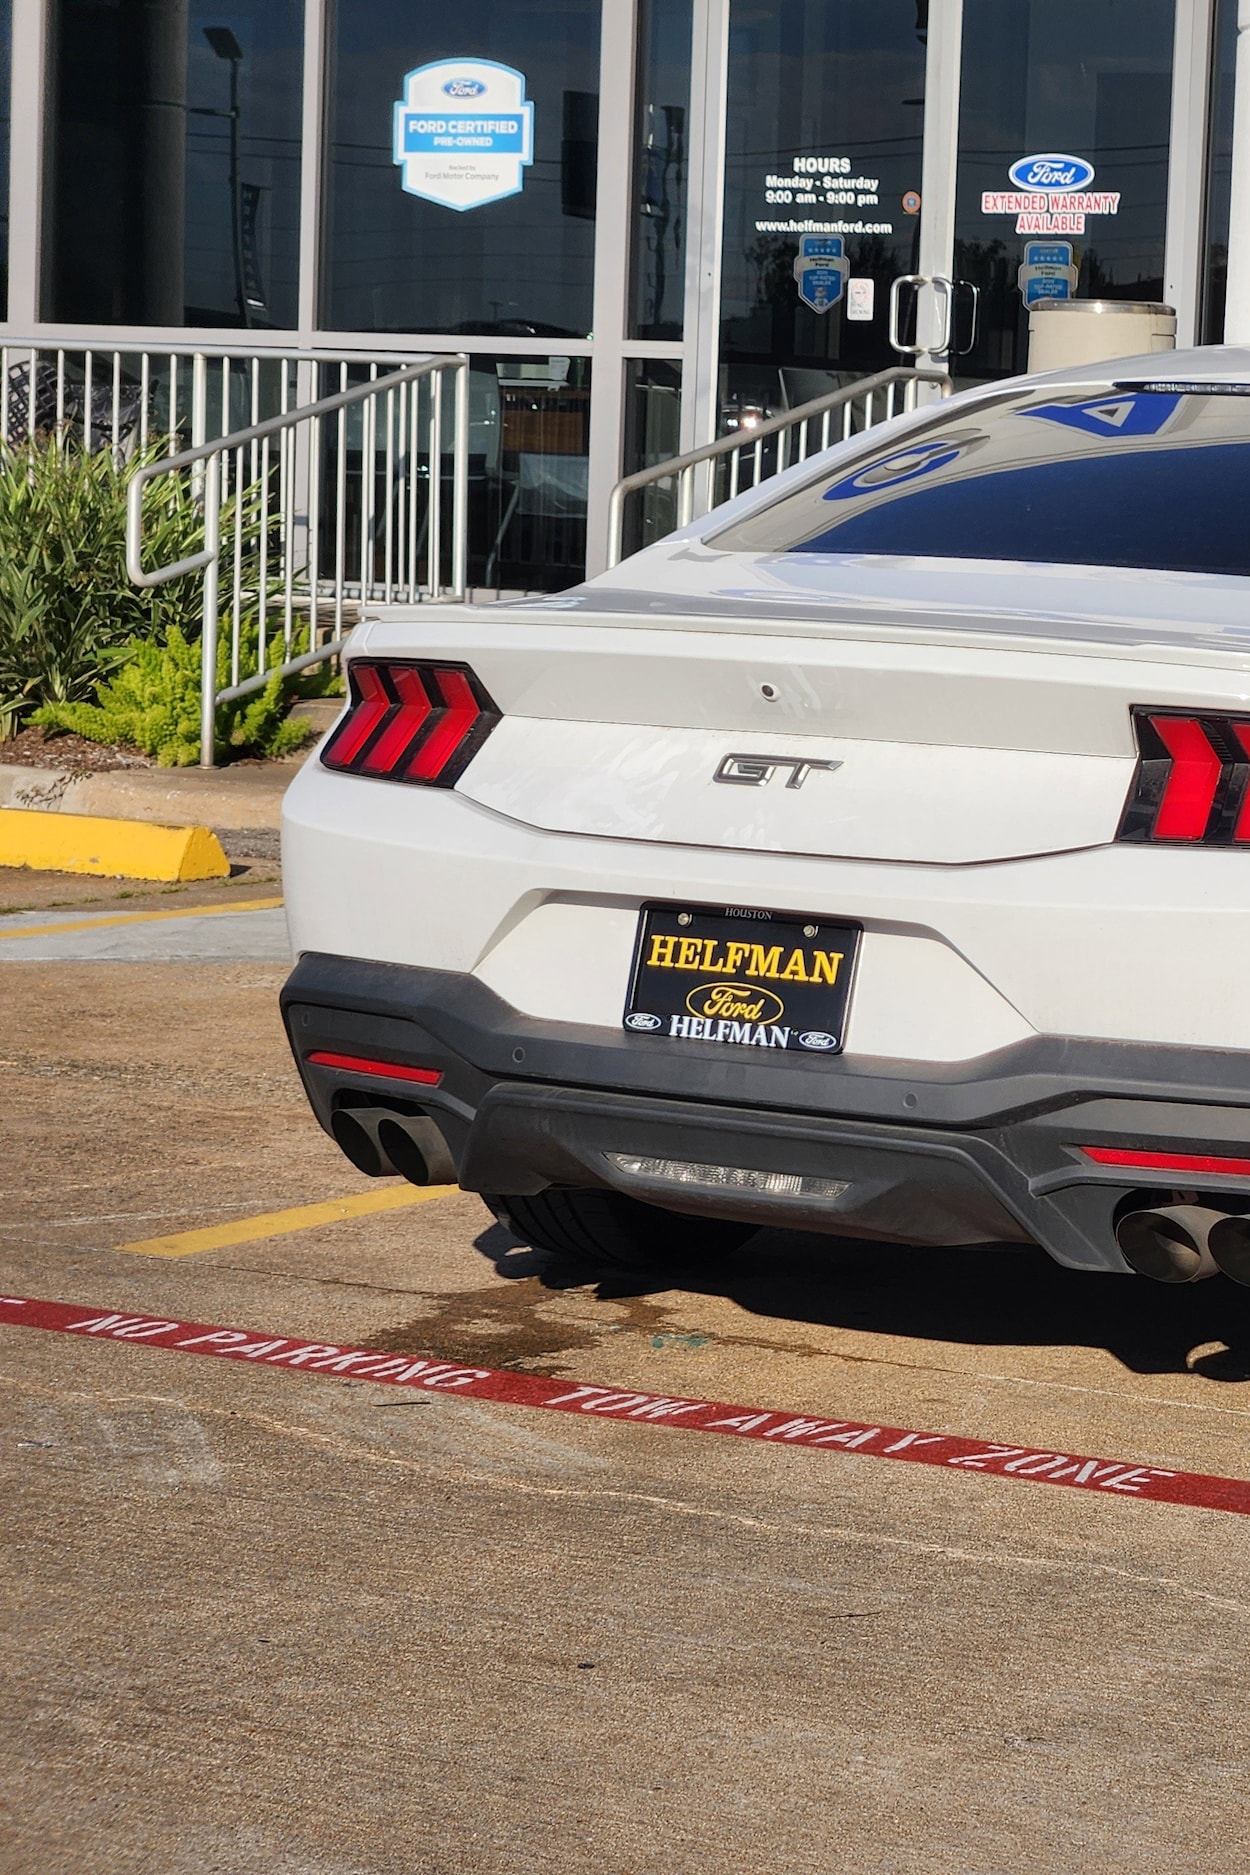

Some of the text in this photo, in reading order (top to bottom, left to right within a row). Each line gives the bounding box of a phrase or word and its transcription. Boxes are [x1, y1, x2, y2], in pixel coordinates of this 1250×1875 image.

[408, 120, 518, 134] FORD CERTIFIED
[433, 136, 493, 147] PRE-OWNED
[793, 157, 851, 174] HOURS
[442, 172, 463, 180] Motor
[464, 172, 499, 181] Company
[765, 175, 814, 191] Monday
[822, 176, 879, 192] Saturday
[765, 190, 793, 204] 9:00
[795, 193, 817, 204] am
[826, 191, 855, 205] 9:00
[857, 194, 879, 207] pm
[983, 193, 1119, 212] EXTENDED WARRANTY
[755, 219, 892, 234] www.helfmanford.com
[1017, 214, 1083, 231] AVAILABLE
[712, 752, 844, 789] GT
[725, 907, 772, 920] HOUSTON
[647, 934, 844, 985] HELFMAN
[703, 986, 765, 1020] Ford
[669, 1014, 792, 1049] HELFMAN
[65, 1314, 492, 1389] NO PARKING
[546, 1386, 1177, 1490] TOW AWAY ZONE
